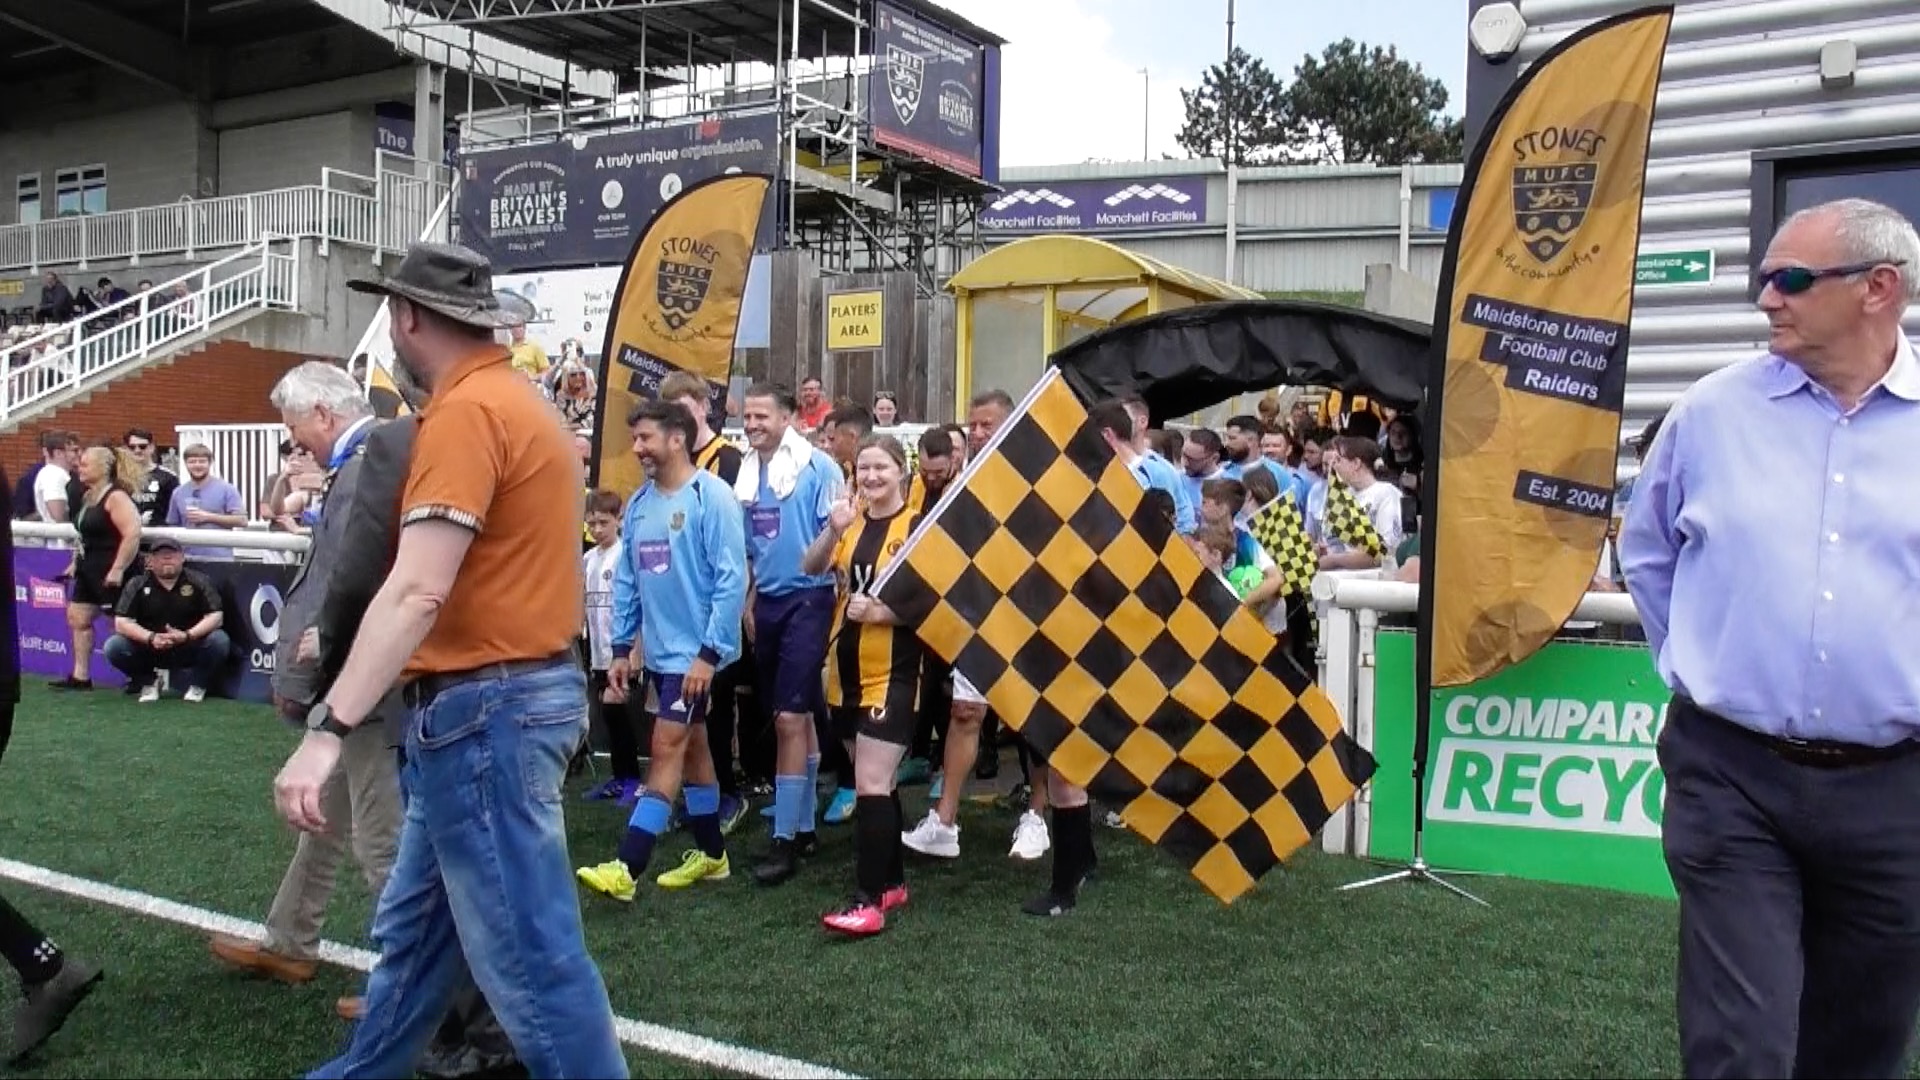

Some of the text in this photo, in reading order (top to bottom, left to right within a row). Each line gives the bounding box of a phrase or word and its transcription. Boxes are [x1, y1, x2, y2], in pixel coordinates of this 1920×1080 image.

[378, 127, 407, 150] The
[1513, 127, 1606, 161] STONES
[595, 157, 605, 170] A
[607, 153, 633, 169] truly
[636, 147, 679, 165] unique
[490, 191, 567, 213] BRITAIN'S
[490, 207, 567, 229] BRAVEST
[983, 214, 1081, 229] Manchett Facilities
[1096, 210, 1197, 225] Manchett Facilities
[661, 237, 720, 264] STONES
[840, 324, 869, 337] AREA
[1473, 302, 1618, 347] Maidstone United
[624, 348, 669, 377] Maidsto
[1499, 333, 1607, 372] Football Club
[1524, 368, 1599, 400] Raiders
[1528, 478, 1607, 510] Est. 2004
